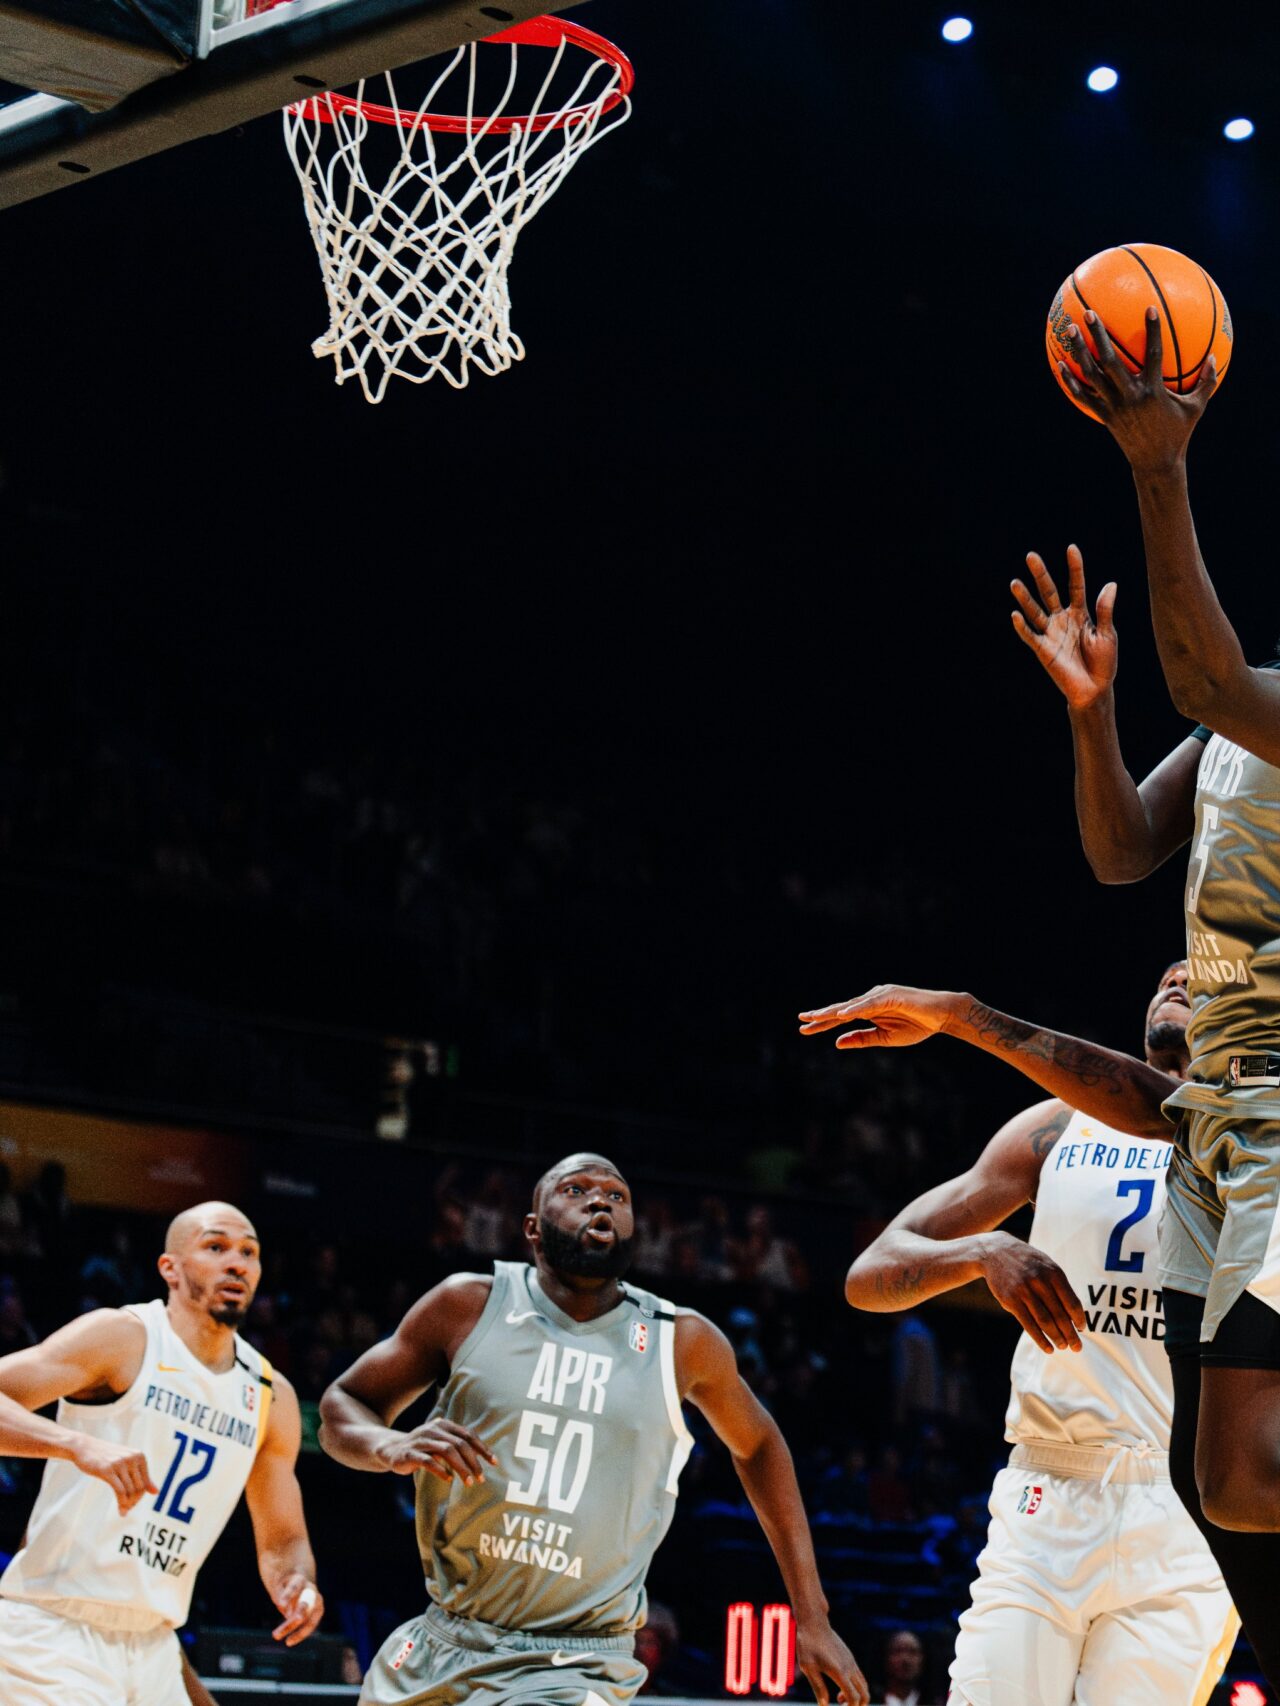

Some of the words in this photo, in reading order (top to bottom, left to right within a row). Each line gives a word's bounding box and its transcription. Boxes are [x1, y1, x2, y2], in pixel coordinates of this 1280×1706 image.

[1197, 733, 1249, 797] APR
[1187, 804, 1219, 914] 5
[1187, 929, 1220, 957] ISIT
[1056, 1143, 1120, 1171] PETRO
[1124, 1147, 1152, 1169] DE
[1105, 1179, 1155, 1273] 2
[1087, 1284, 1164, 1313] VISIT
[144, 1384, 190, 1421] PETRO
[190, 1403, 210, 1429] DE
[527, 1342, 613, 1415] APR
[153, 1430, 218, 1524] 12
[505, 1410, 594, 1514] 50
[479, 1533, 583, 1580] RWANDA
[503, 1513, 572, 1548] VISIT
[725, 1602, 794, 1696] 00
